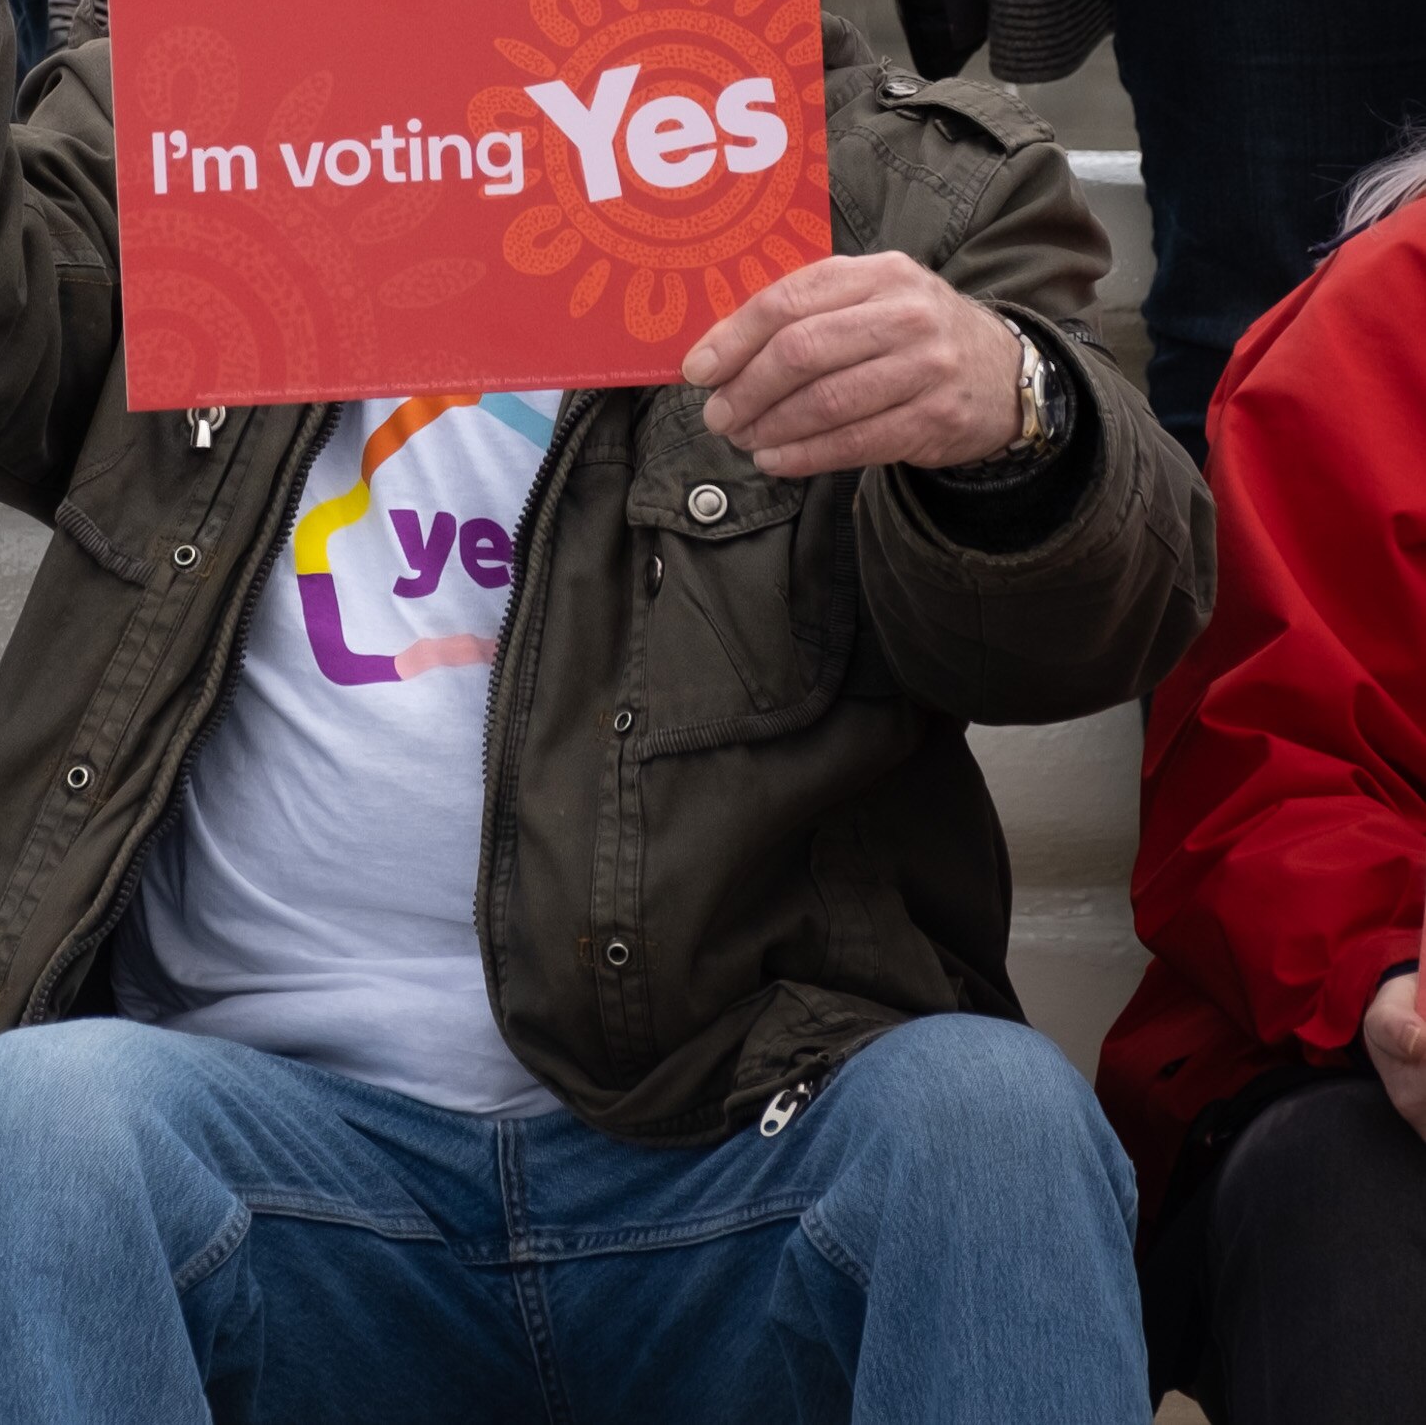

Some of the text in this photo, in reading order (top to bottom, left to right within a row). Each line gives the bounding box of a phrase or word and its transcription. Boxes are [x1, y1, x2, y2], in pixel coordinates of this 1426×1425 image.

[152, 64, 789, 203] I'm voting Yes
